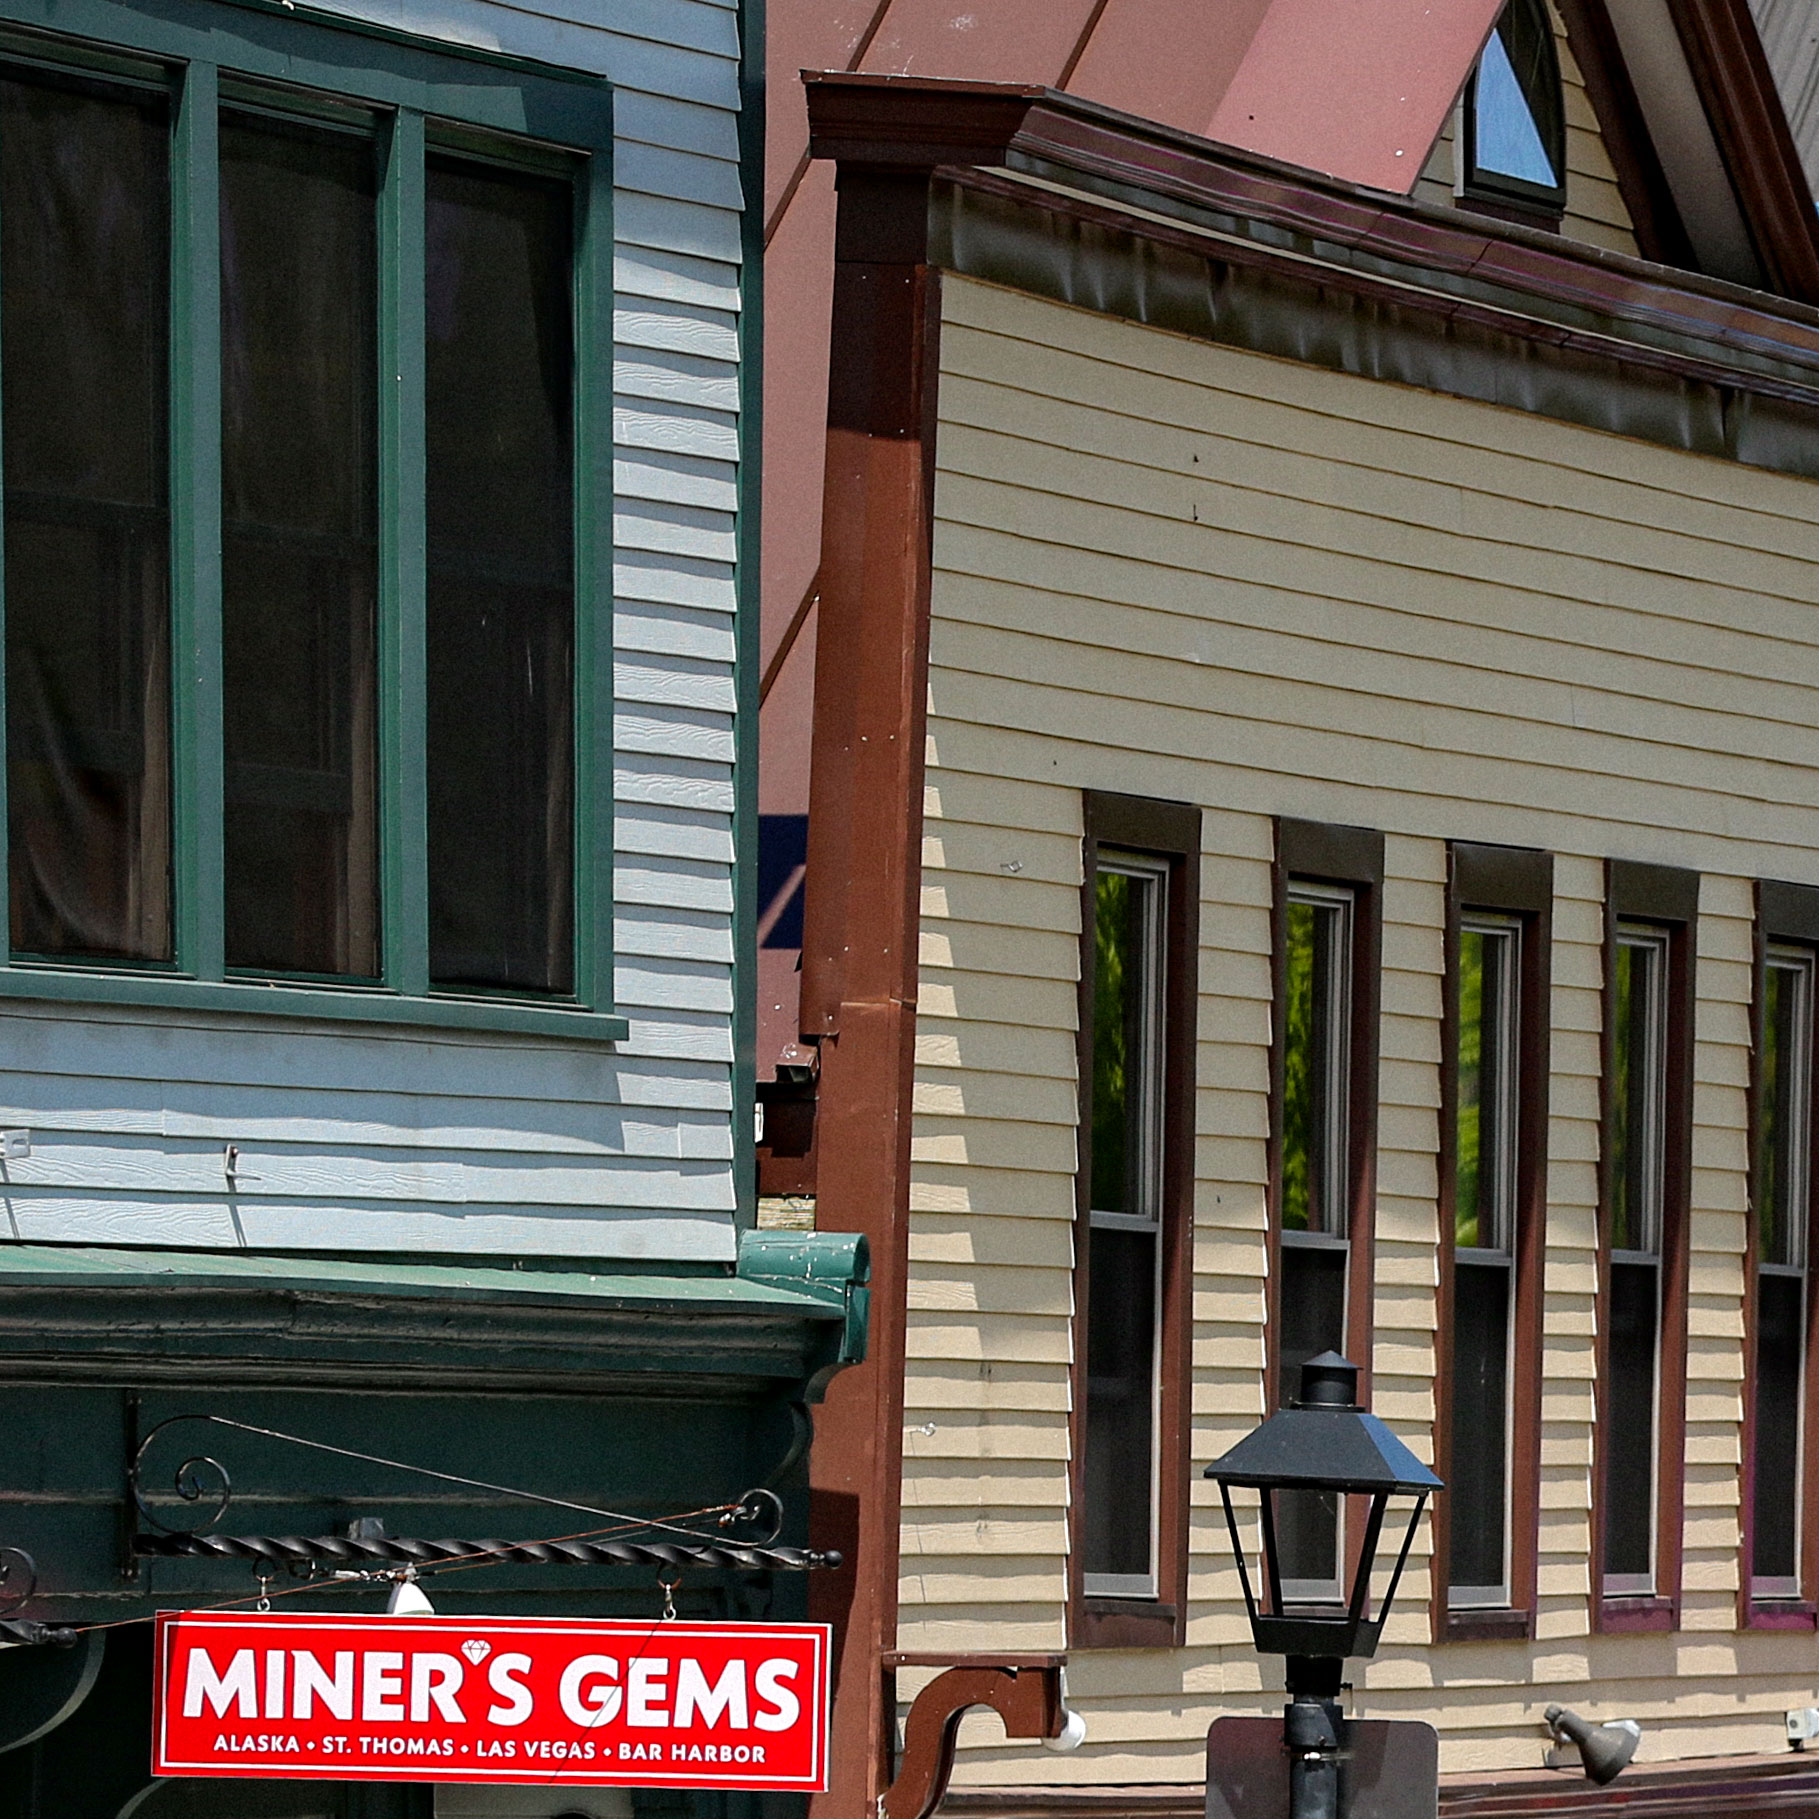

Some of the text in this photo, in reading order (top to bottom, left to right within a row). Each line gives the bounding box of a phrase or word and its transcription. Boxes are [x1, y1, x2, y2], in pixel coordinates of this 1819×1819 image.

[559, 1653, 802, 1732] GEMS
[213, 1734, 765, 1764] ALASKA ST. THOMAS LAS VEGAS BAR HARBOR
